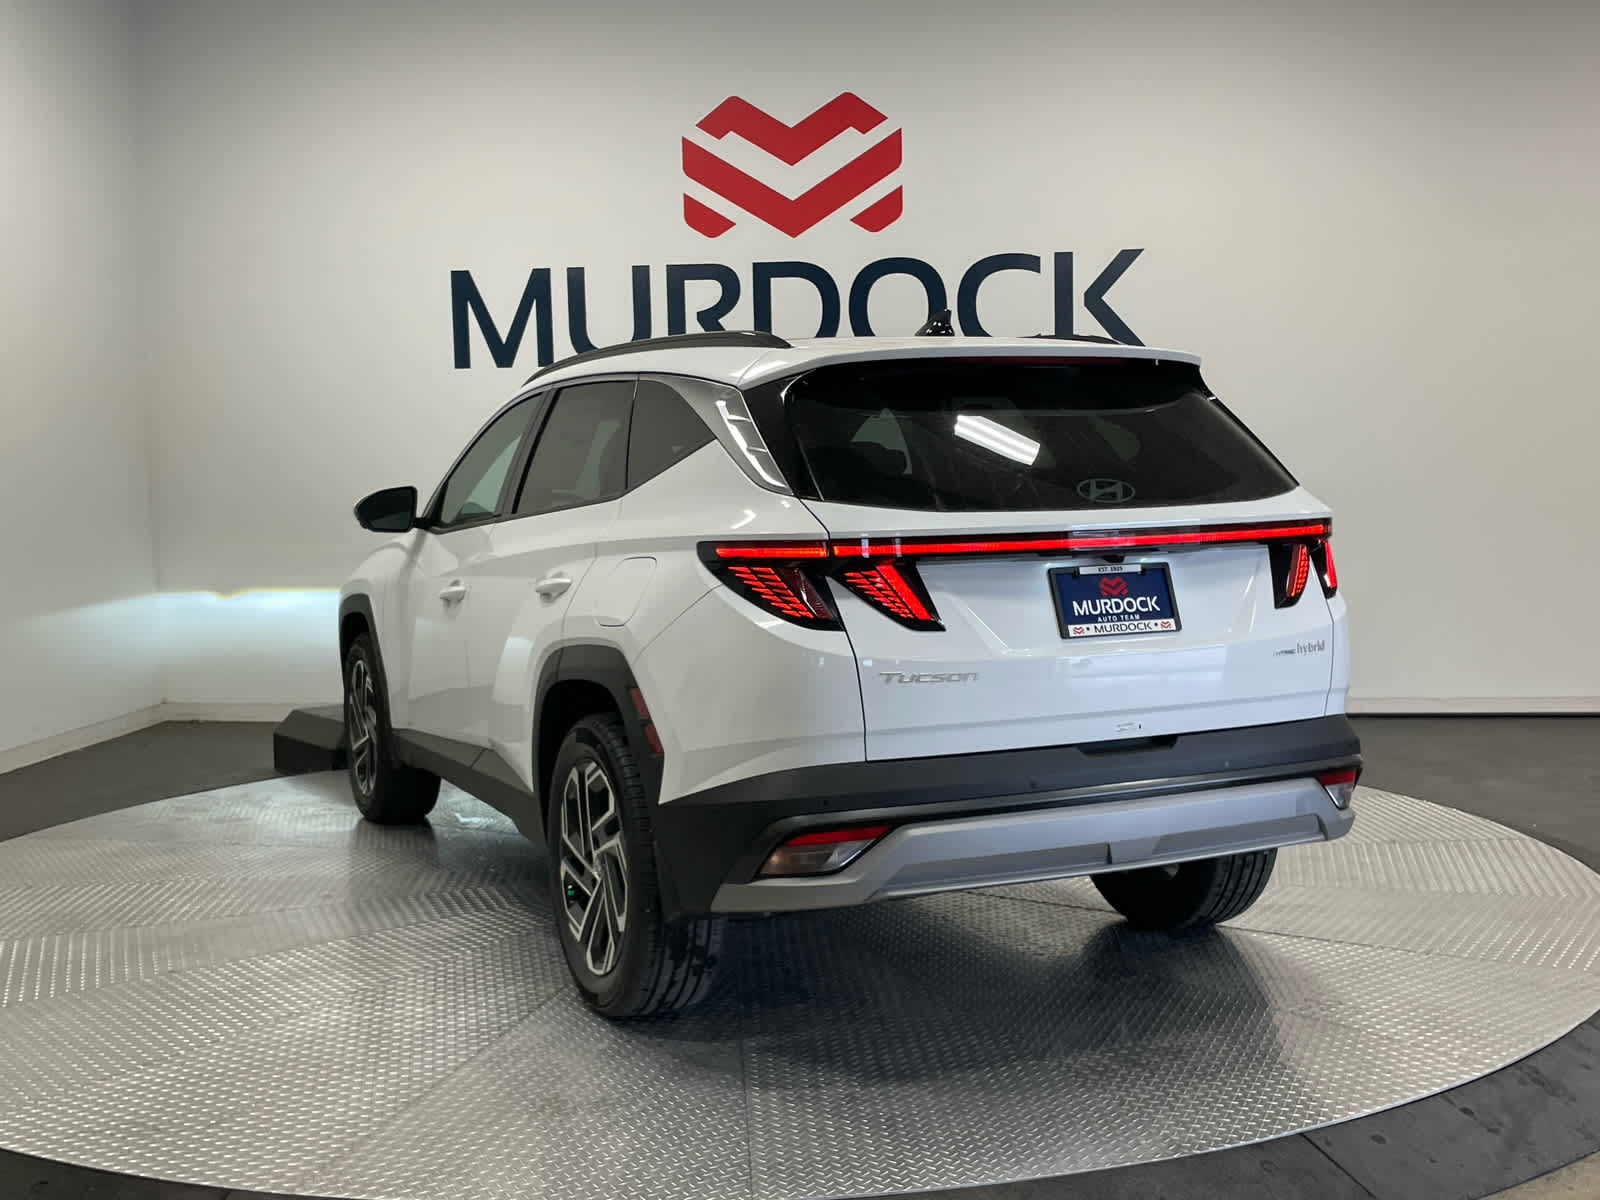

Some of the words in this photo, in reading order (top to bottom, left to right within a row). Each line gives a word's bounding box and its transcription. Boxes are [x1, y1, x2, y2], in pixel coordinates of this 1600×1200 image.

[450, 248, 1146, 370] MURDOCK
[1072, 596, 1160, 616] MURDOCK
[1094, 621, 1152, 633] MURDOCK
[1296, 640, 1325, 655] hybrid
